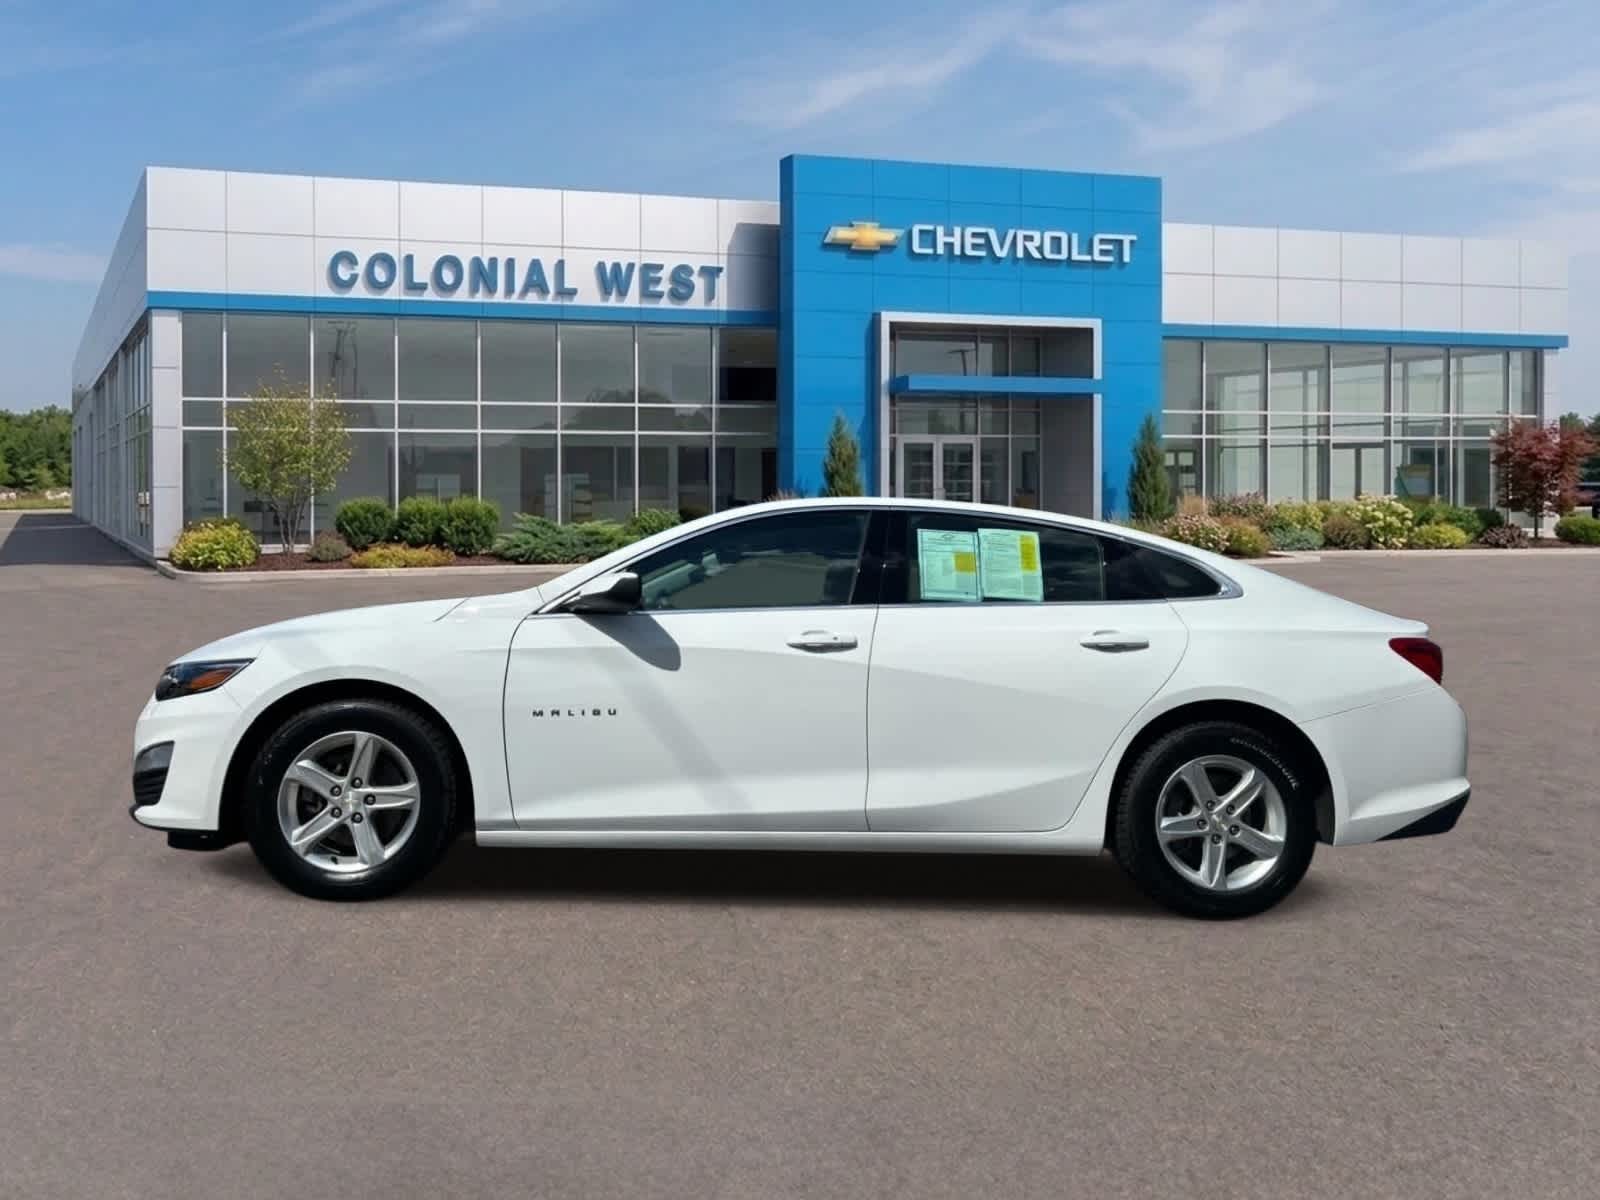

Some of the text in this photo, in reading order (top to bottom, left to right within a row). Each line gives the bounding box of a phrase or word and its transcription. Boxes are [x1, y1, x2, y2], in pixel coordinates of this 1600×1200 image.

[911, 223, 1137, 263] CHEVROLET
[327, 250, 724, 303] COLONIAL WEST
[532, 708, 617, 717] MALIBU
